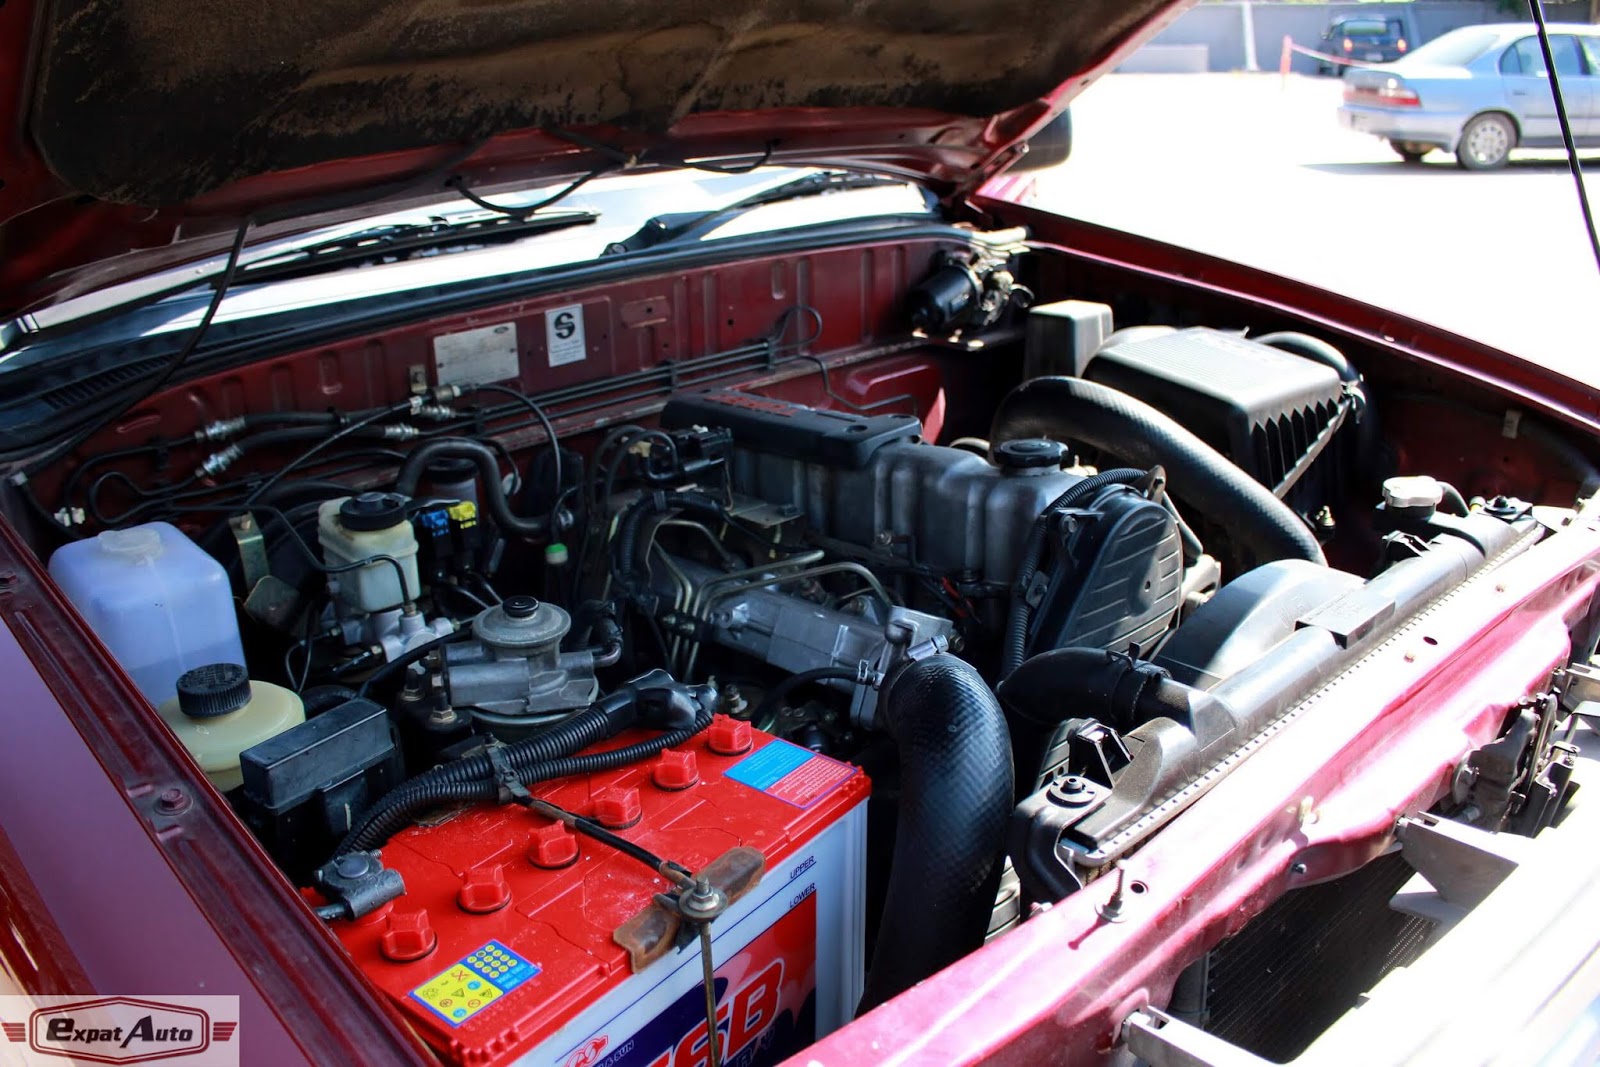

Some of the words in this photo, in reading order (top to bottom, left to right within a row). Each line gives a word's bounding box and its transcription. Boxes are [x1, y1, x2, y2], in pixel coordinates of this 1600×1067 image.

[790, 855, 815, 879] UPPER
[789, 882, 816, 908] LOWER
[645, 957, 786, 1067] SB
